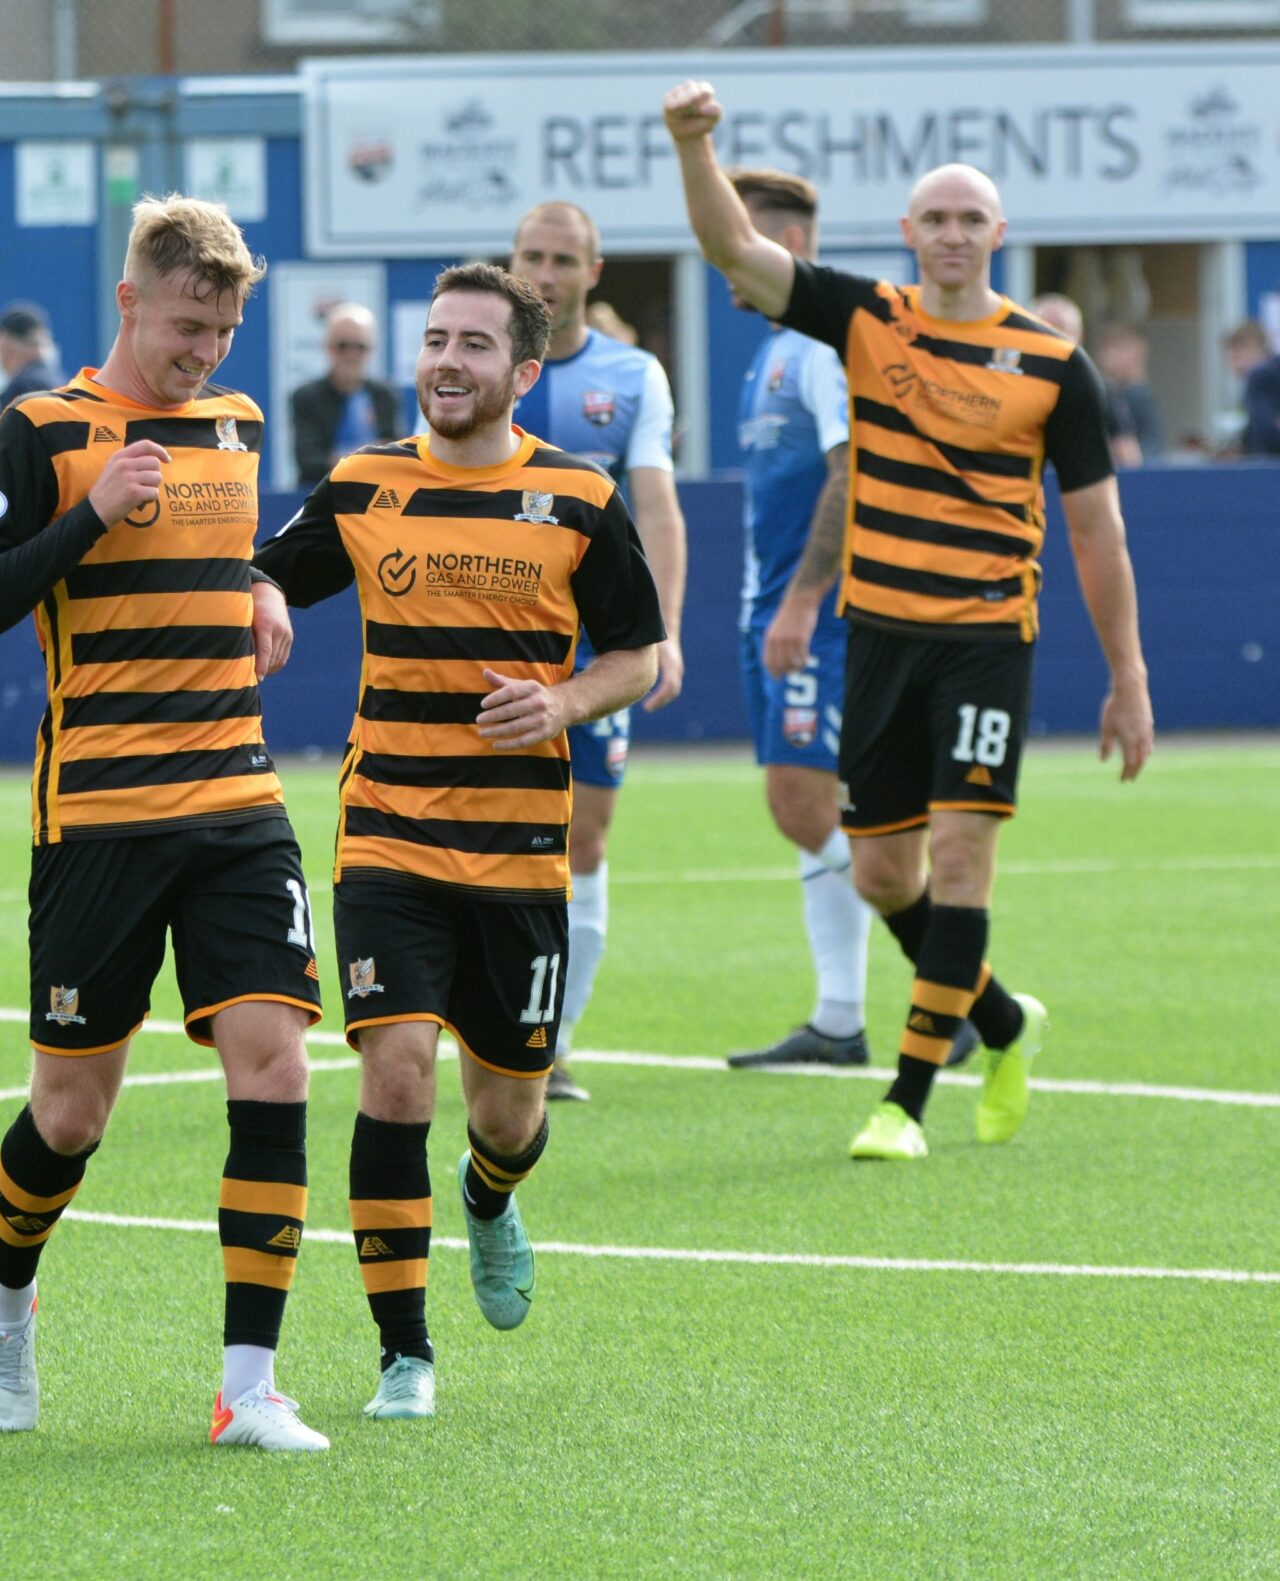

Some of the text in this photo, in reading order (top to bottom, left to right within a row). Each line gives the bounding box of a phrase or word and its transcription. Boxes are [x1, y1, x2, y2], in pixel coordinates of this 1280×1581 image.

[540, 104, 1142, 192] REFESHMENTS
[164, 482, 254, 499] NORTHERN
[169, 501, 193, 512] GAS
[195, 500, 221, 512] AND
[171, 518, 185, 527] THE
[426, 553, 543, 580] NORTHERN
[425, 571, 541, 594] GAS AND POWER
[426, 589, 442, 598] THE
[443, 591, 477, 600] SMARTER
[477, 592, 509, 602] ENERGY
[785, 656, 818, 706] 5
[952, 702, 1011, 768] 18
[286, 879, 317, 954] 1
[520, 953, 560, 1024] 11
